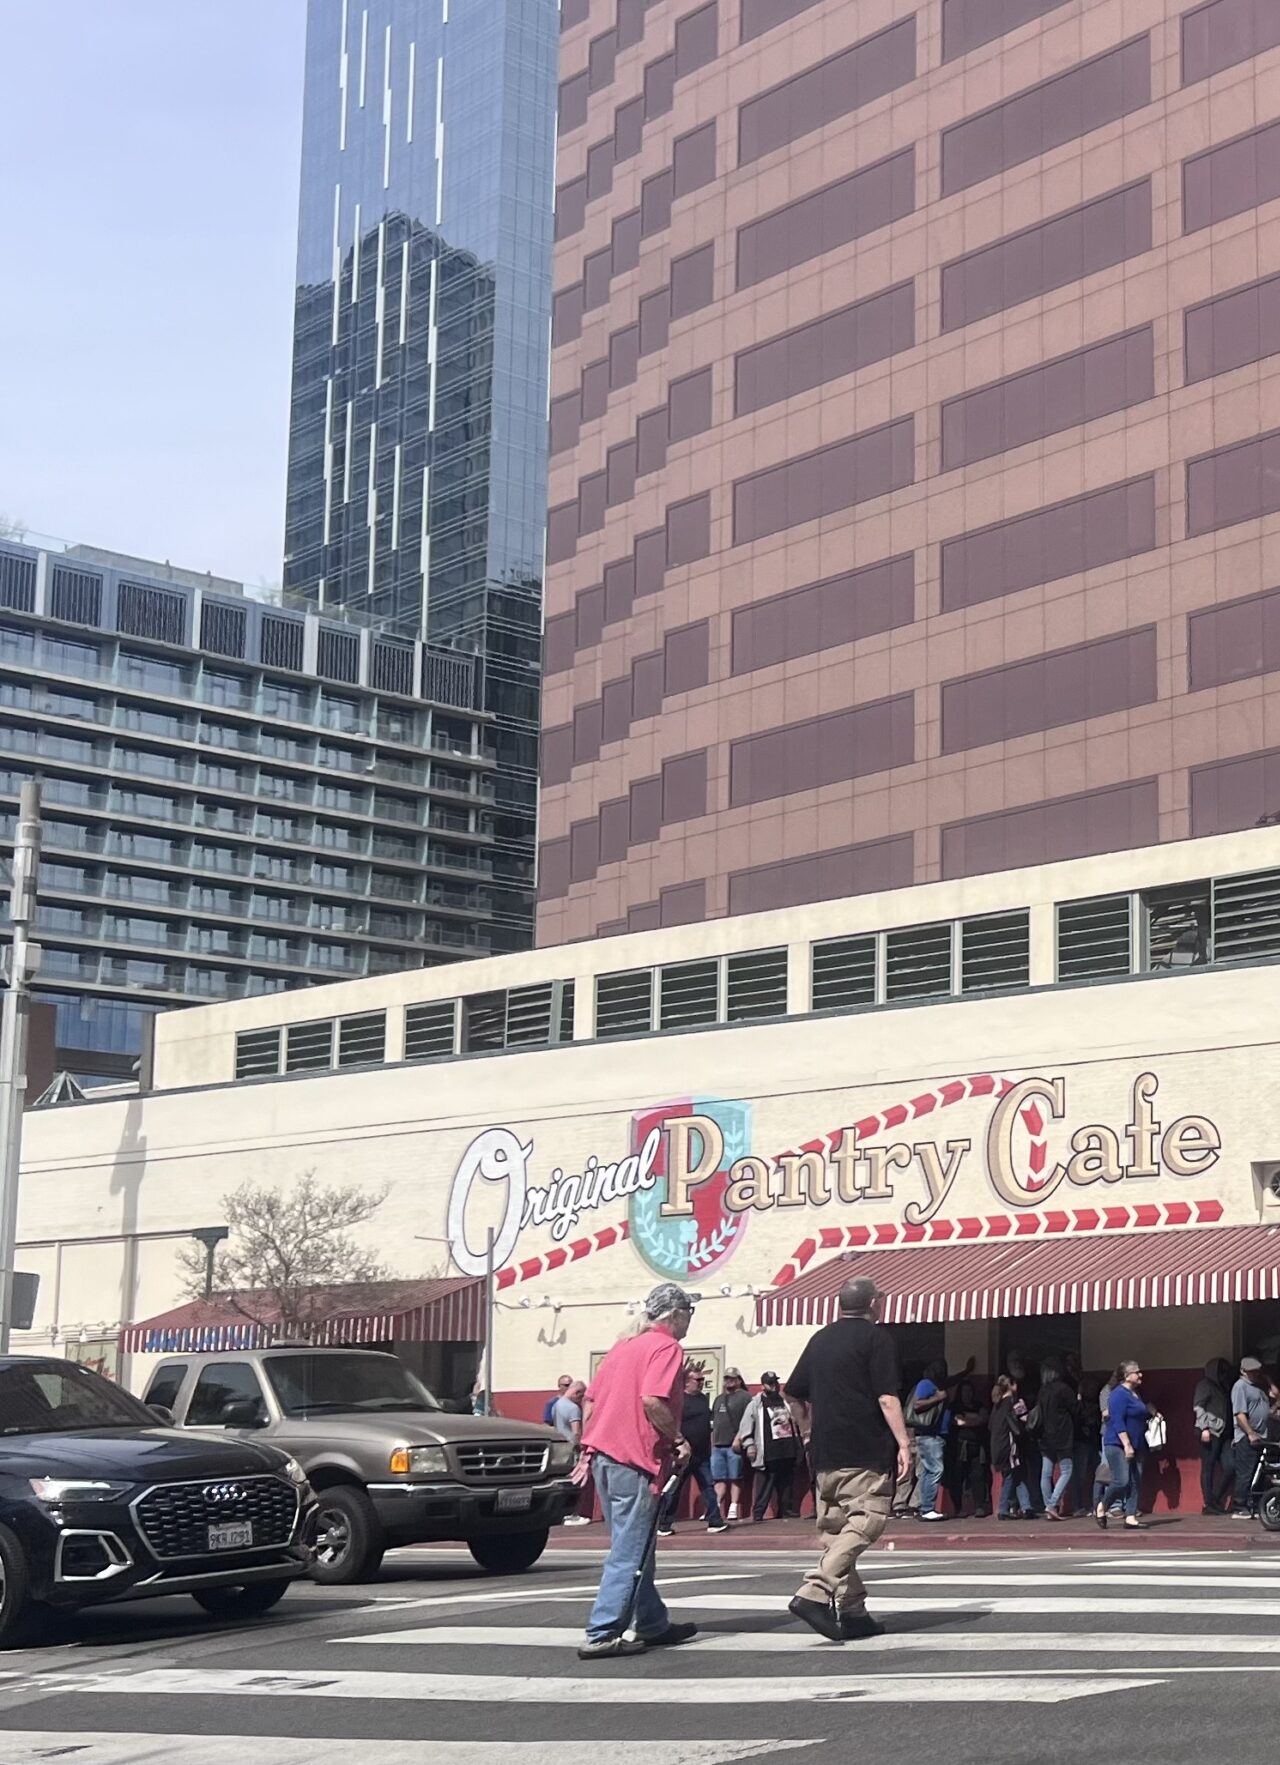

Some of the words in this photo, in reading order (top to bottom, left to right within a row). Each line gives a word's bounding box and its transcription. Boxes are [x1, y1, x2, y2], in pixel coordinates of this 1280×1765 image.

[447, 1127, 661, 1277] Original
[659, 1115, 971, 1225] Pantry
[988, 1071, 1222, 1207] Cafe
